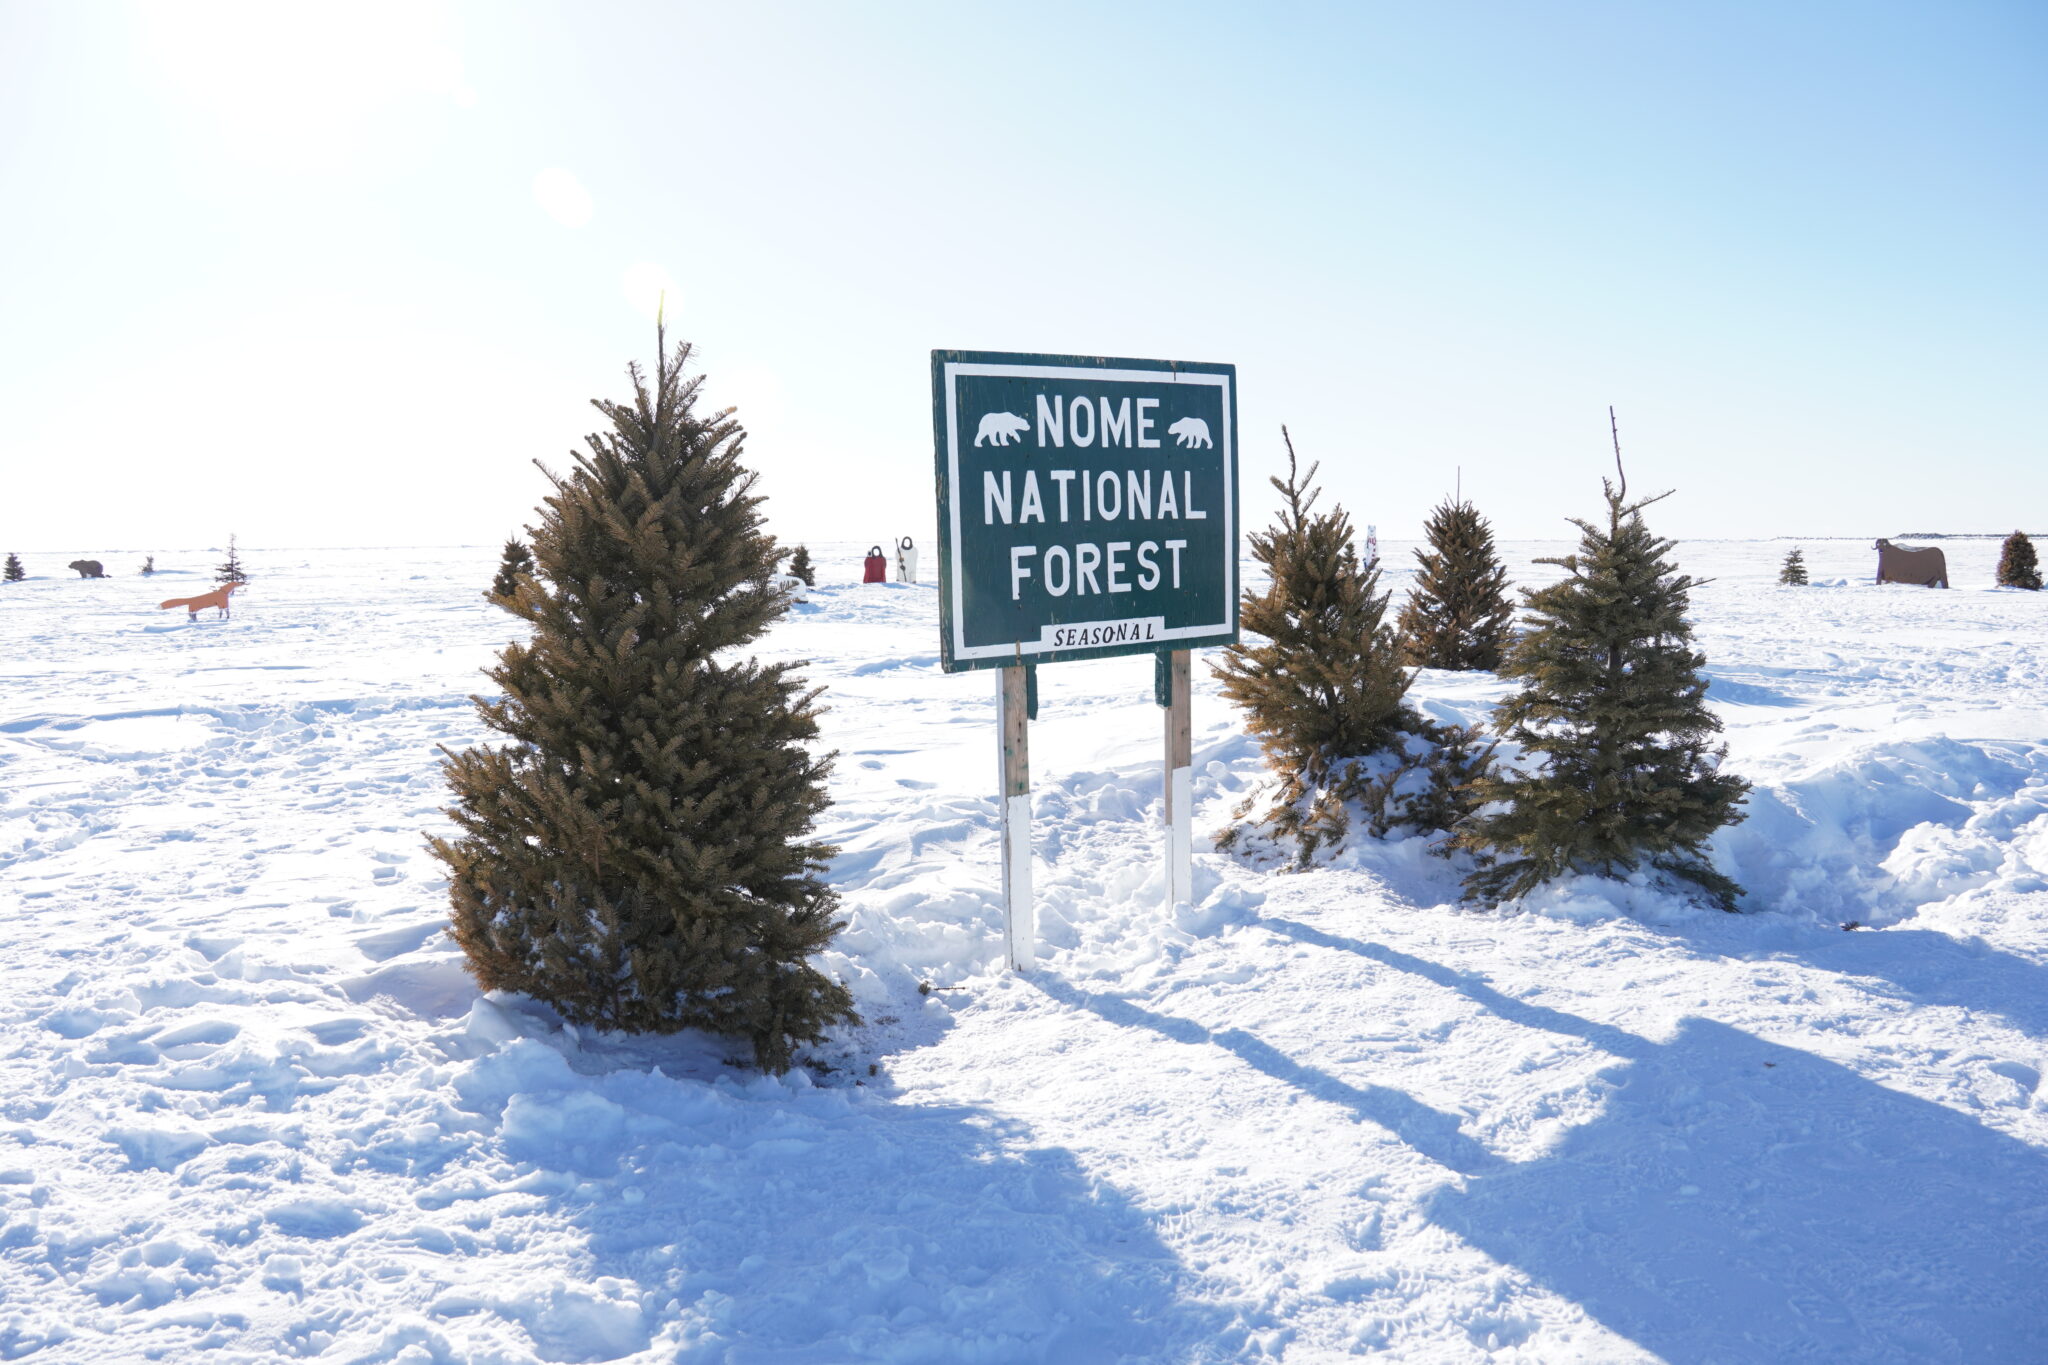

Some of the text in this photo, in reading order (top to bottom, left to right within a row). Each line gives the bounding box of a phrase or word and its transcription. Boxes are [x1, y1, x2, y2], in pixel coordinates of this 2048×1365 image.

[1036, 394, 1161, 449] NOME
[983, 469, 1207, 525] NATIONAL
[1010, 539, 1187, 600] FOREST
[1054, 623, 1154, 647] SEASONAL
